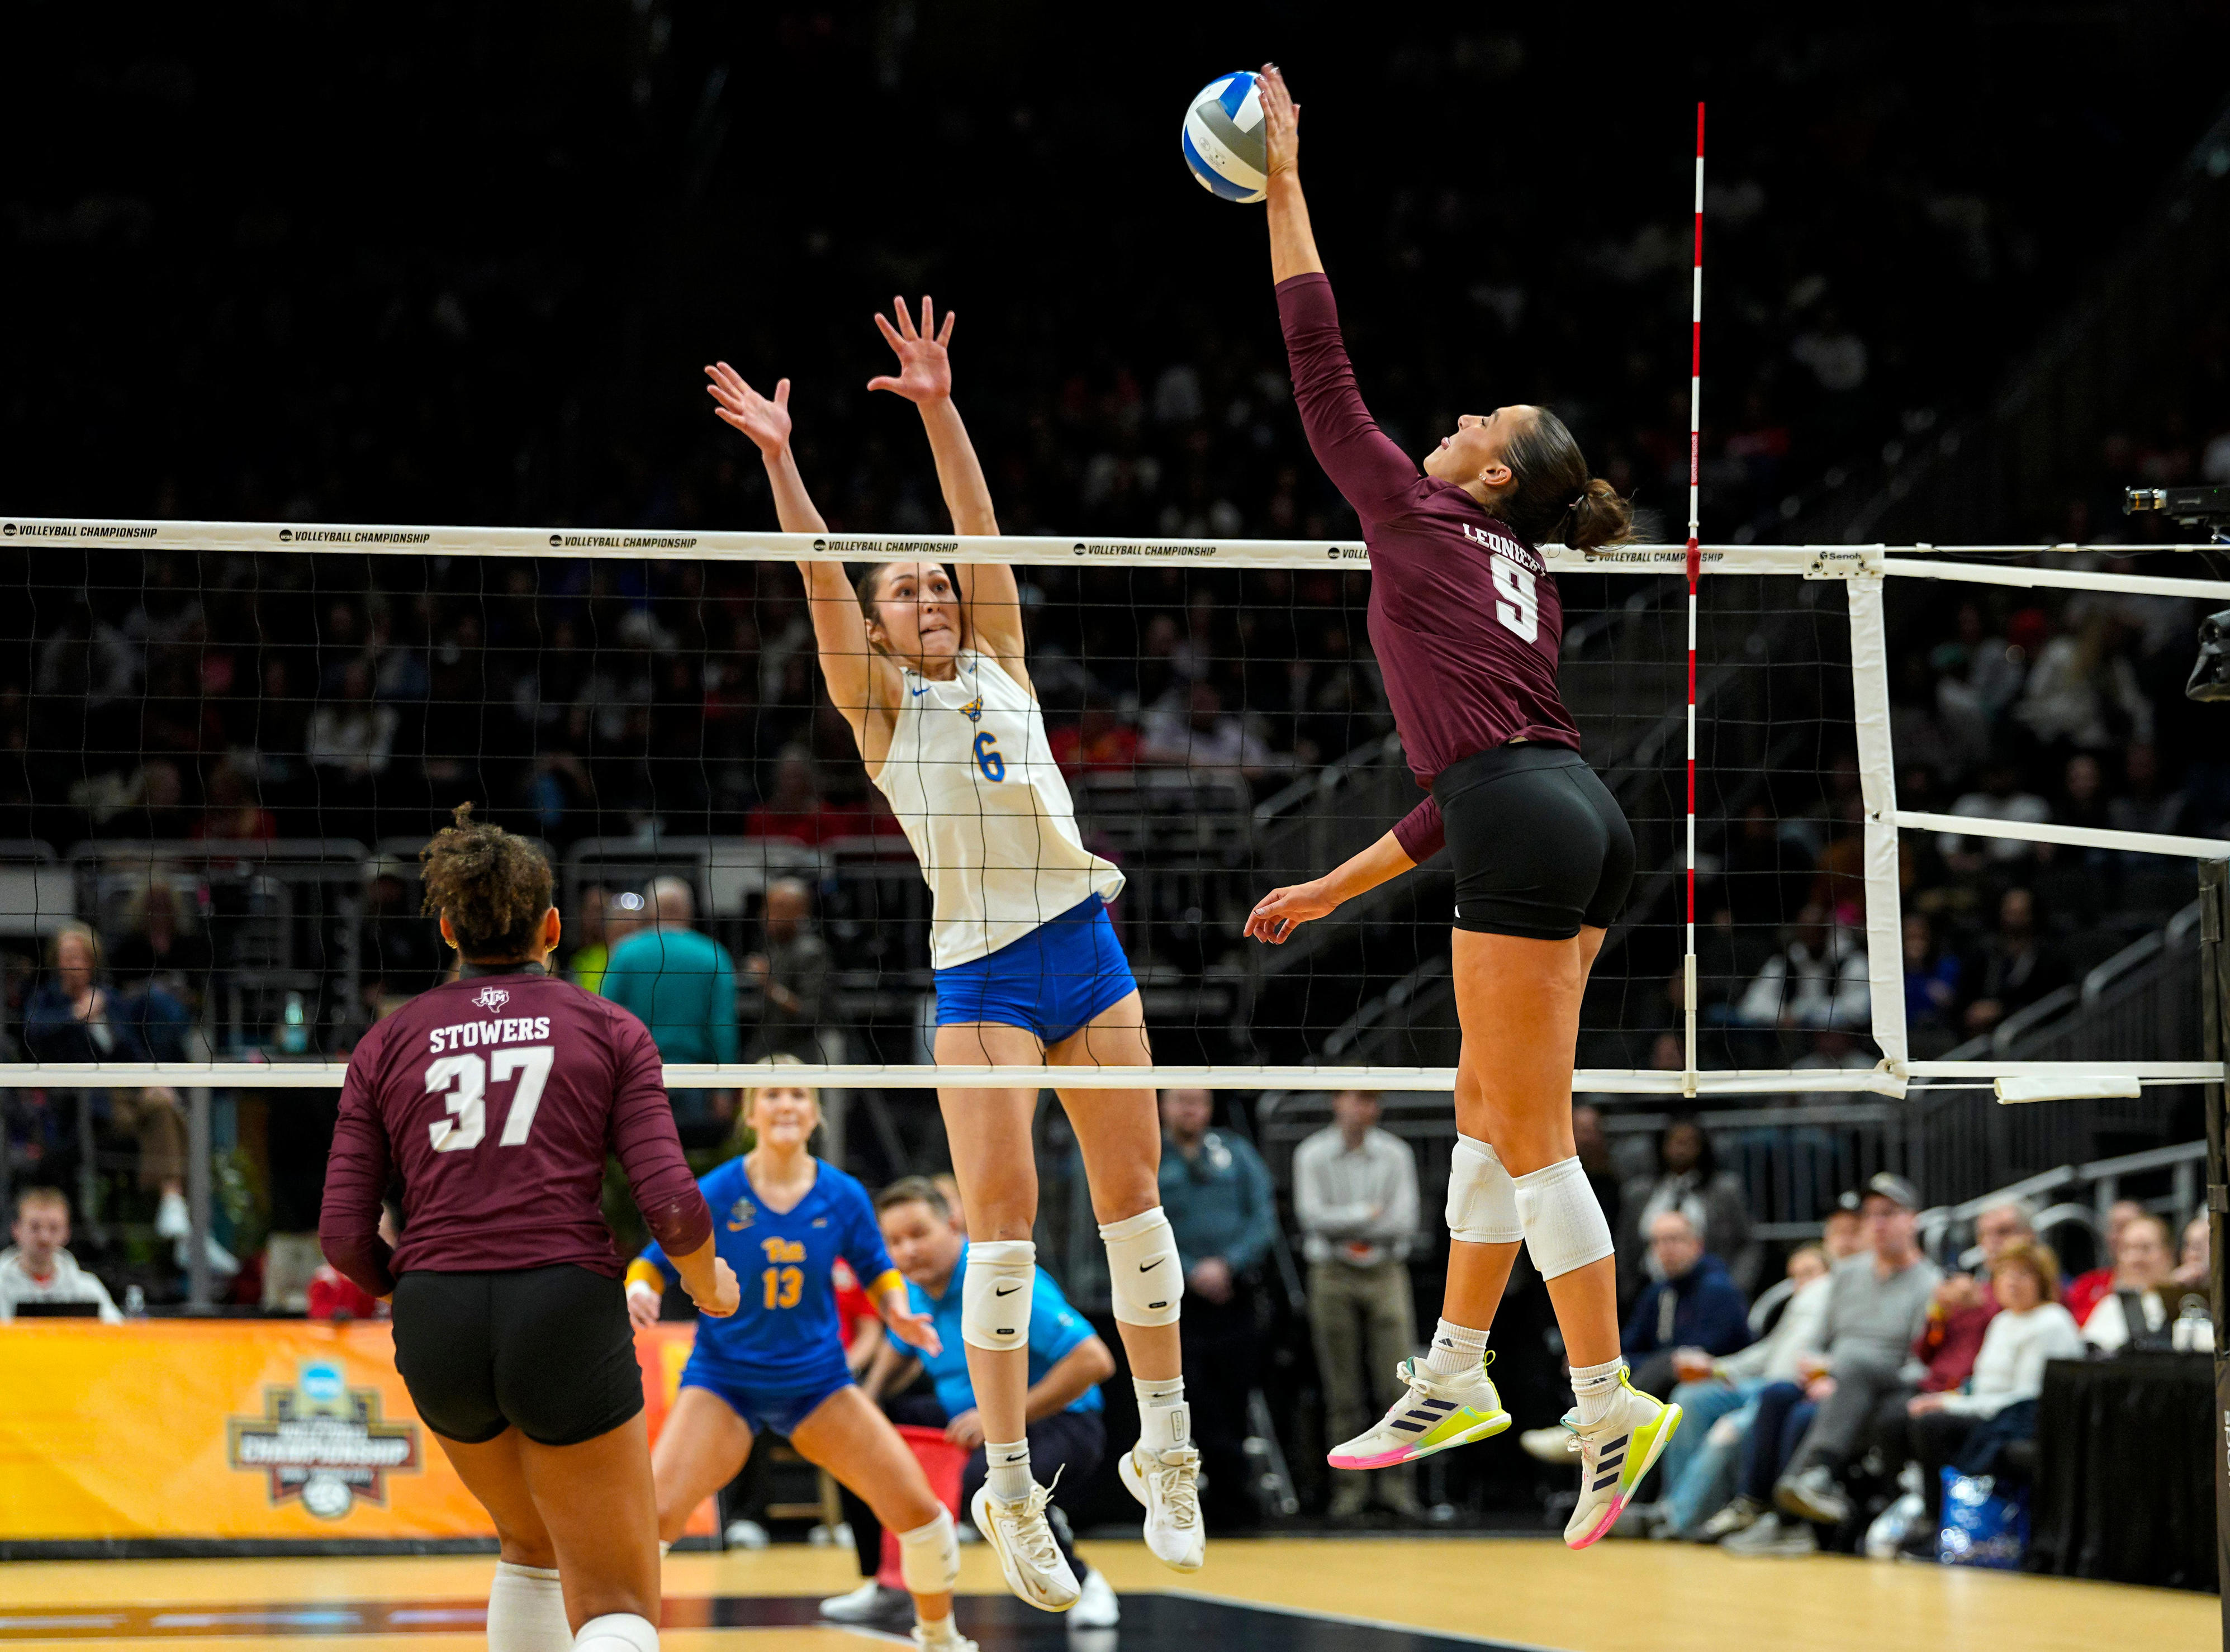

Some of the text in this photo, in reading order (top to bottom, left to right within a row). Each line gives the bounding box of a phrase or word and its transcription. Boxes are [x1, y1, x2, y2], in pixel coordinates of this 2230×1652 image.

[20, 525, 77, 536] VOLLEYBALL
[80, 527, 157, 538] CHAMPIONSHIP
[295, 531, 351, 542] VOLLEYBALL
[354, 533, 430, 543] CHAMPIONSHIP
[565, 537, 620, 547] VOLLEYBALL
[623, 538, 697, 548] CHAMPIONSHIP
[829, 541, 958, 552] VOLLEYBALL CHAMPIONSHIP
[1089, 545, 1216, 556] VOLLEYBALL CHAMPIONSHIP
[1343, 549, 1368, 559] VOLLE
[1654, 553, 1723, 562] CHAMPSHIP
[1490, 553, 1539, 644] 9
[974, 731, 1006, 783] 6
[430, 1016, 550, 1053] STOWERS
[425, 1046, 554, 1153] 37
[761, 1265, 805, 1310] 13
